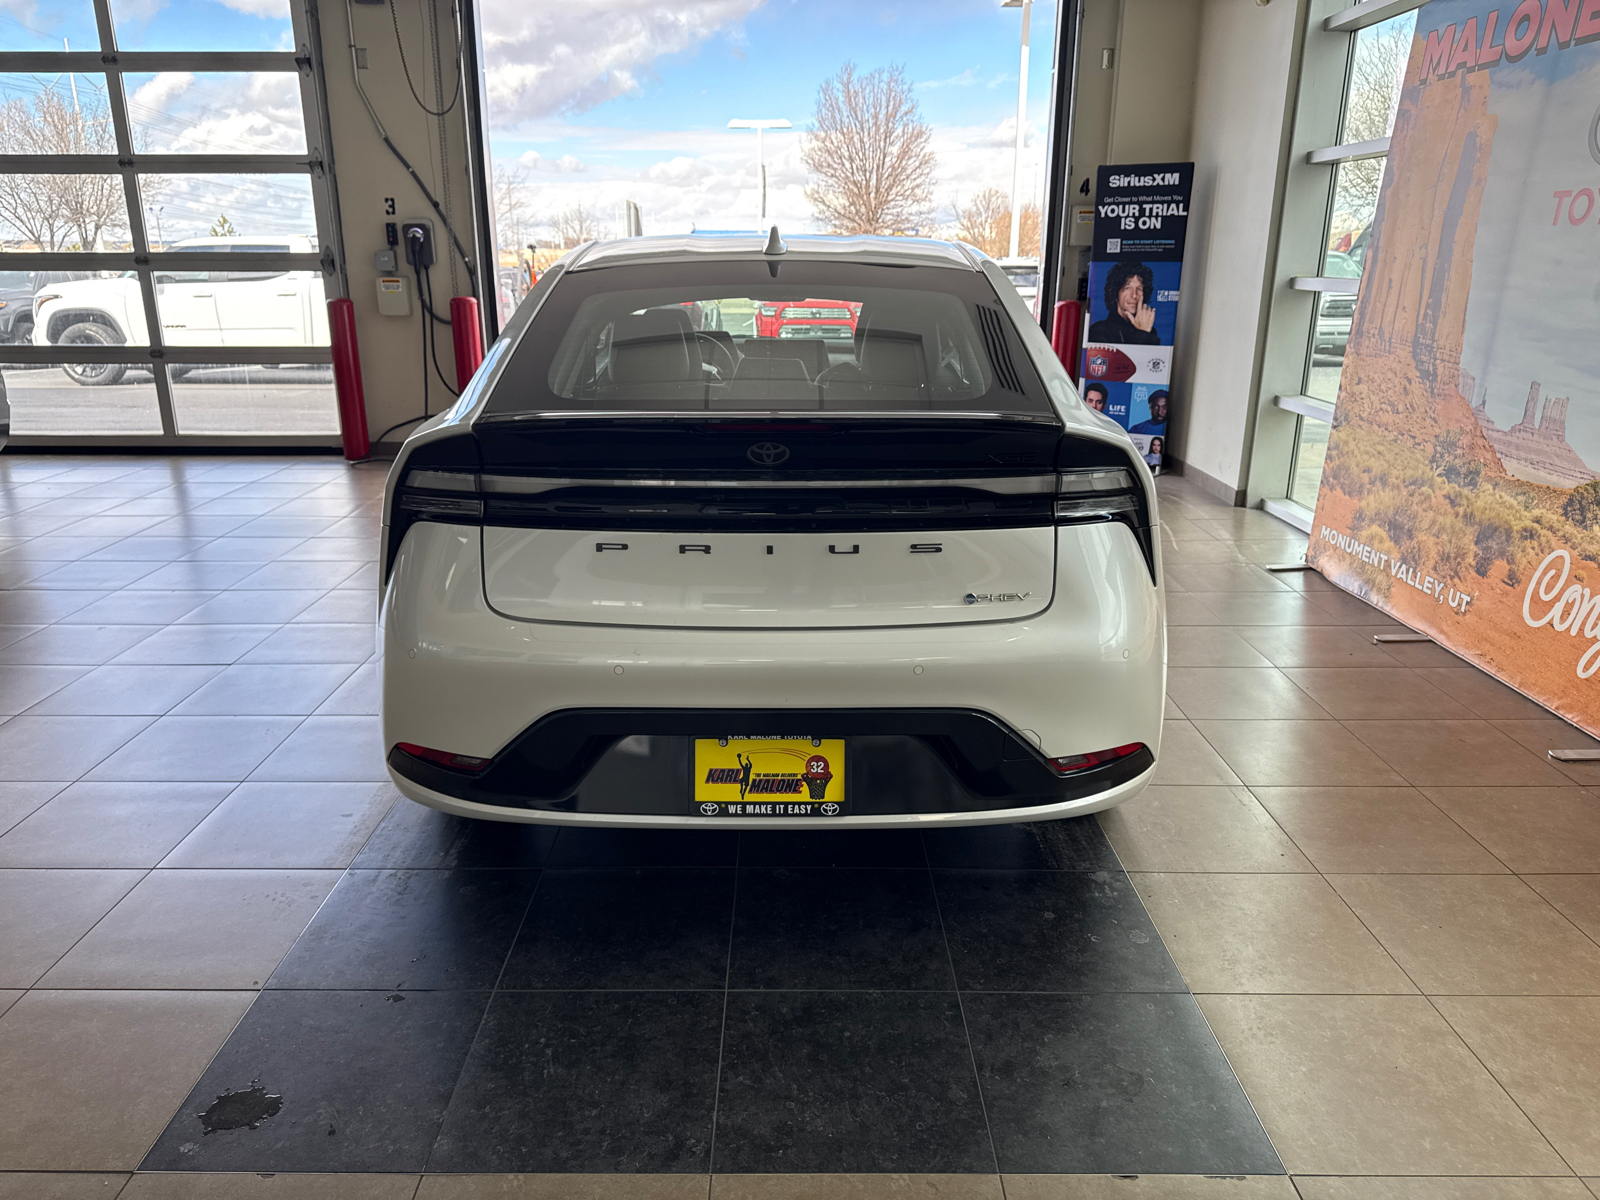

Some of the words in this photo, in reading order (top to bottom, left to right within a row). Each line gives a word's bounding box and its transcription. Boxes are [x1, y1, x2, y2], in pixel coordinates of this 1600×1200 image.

[1079, 177, 1090, 196] 4
[1109, 173, 1180, 188] SiriusXM
[384, 197, 396, 216] 3
[1098, 204, 1140, 218] YOUR
[1142, 203, 1188, 216] TRIAL
[1552, 187, 1600, 227] TO
[1121, 217, 1135, 230] IS
[1138, 217, 1162, 230] ON
[1091, 364, 1106, 376] NFL
[1109, 404, 1126, 412] LIFE
[595, 542, 943, 555] PRIUS
[1320, 524, 1388, 571] MONUMENT
[1390, 558, 1444, 605] VALLEY,
[1448, 590, 1471, 613] UT
[810, 761, 825, 773] 32
[705, 768, 742, 784] KARL
[748, 778, 804, 794] MALONE
[728, 805, 742, 814] WE
[746, 805, 773, 814] MAKE
[776, 805, 784, 814] IT
[788, 805, 812, 814] EASY
